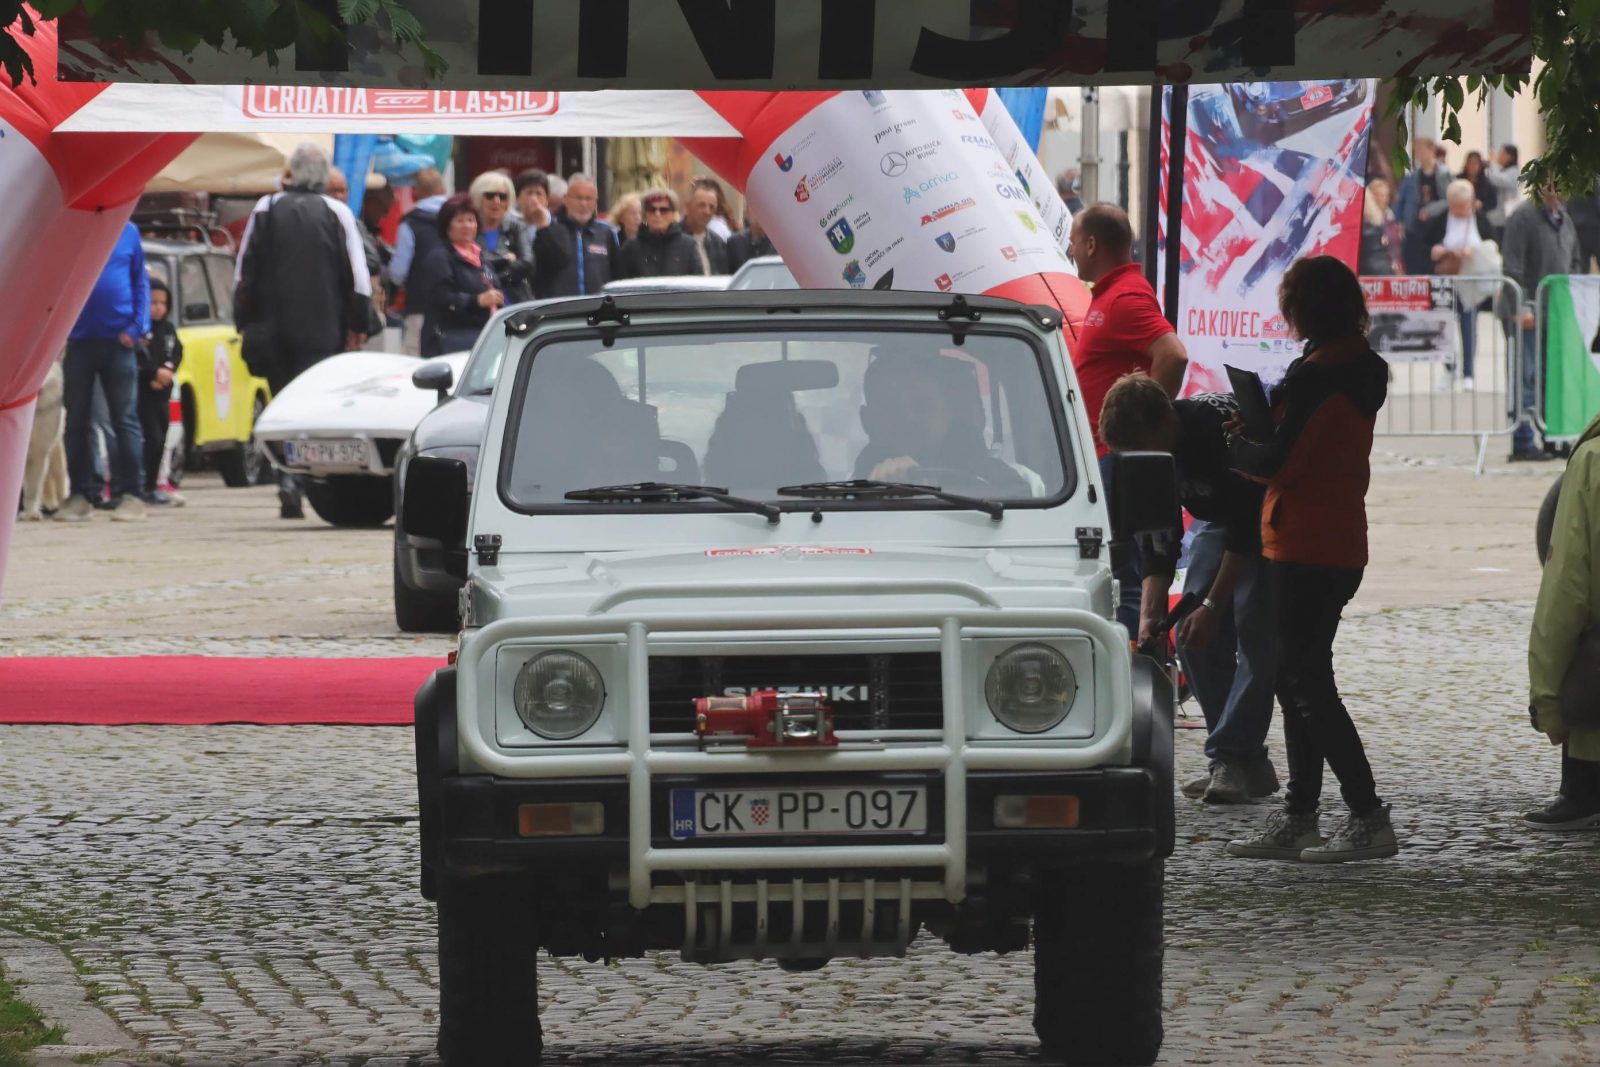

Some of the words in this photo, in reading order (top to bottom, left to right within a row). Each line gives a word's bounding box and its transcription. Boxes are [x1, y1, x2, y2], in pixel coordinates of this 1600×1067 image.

[264, 86, 368, 114] CROATIA
[434, 90, 538, 113] CLASSIC
[1188, 306, 1260, 338] ČAKOVEC
[675, 819, 693, 831] HR
[700, 793, 744, 832] ČK
[778, 790, 919, 830] PP-097
